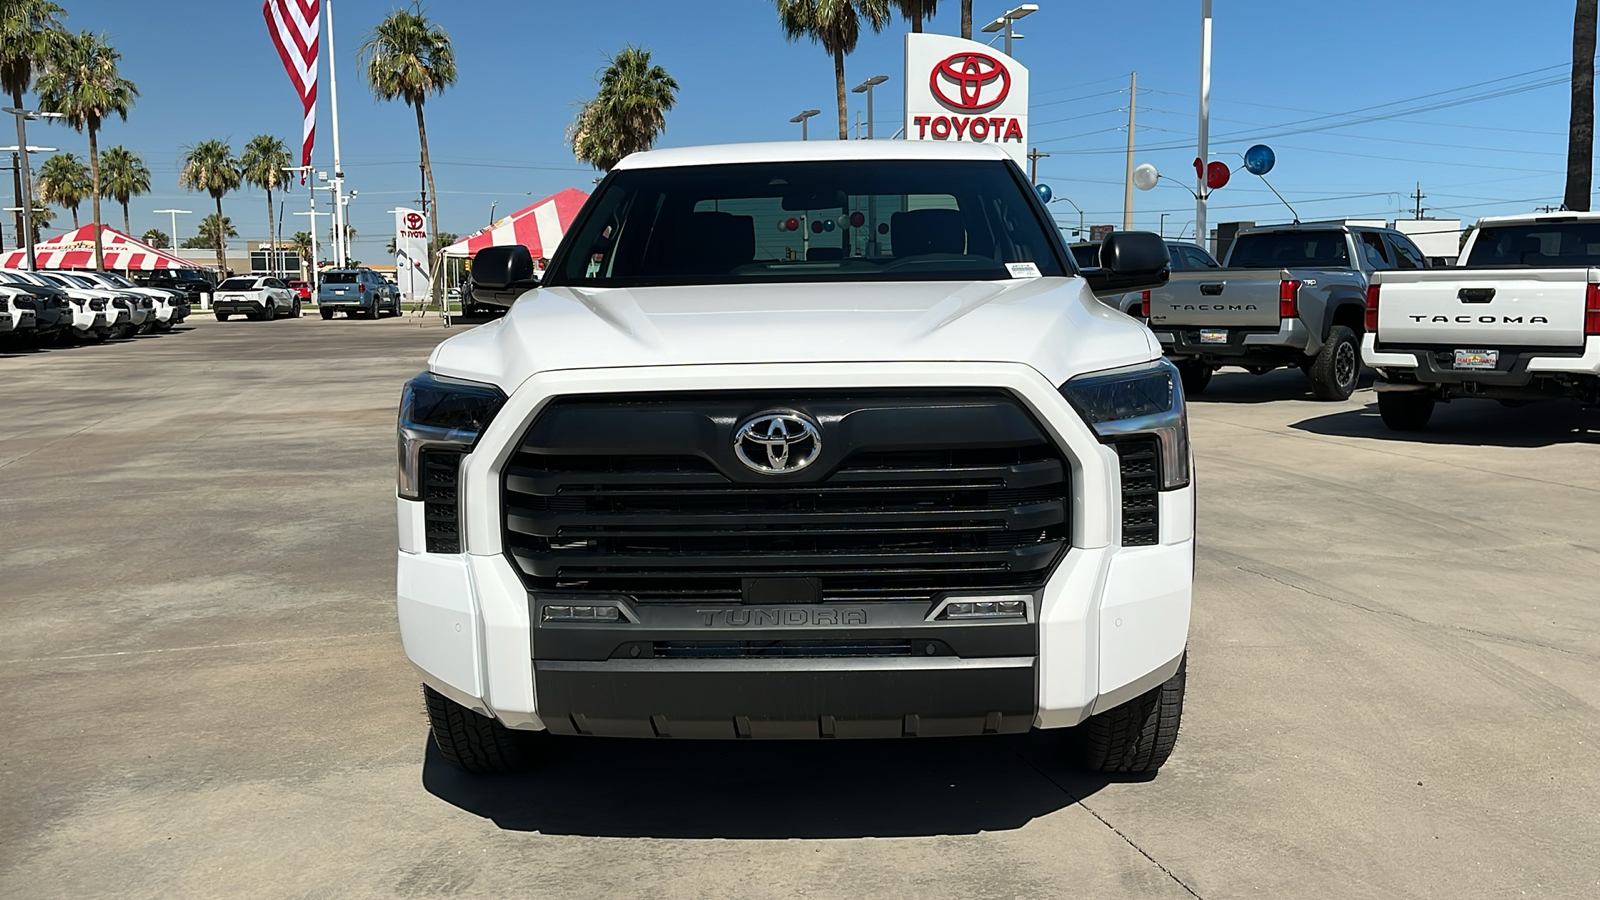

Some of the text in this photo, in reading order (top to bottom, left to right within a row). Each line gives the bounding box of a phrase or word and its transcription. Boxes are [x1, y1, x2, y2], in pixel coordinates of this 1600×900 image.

[914, 116, 1023, 143] TOYOTA
[1409, 315, 1548, 324] TACOMA
[696, 608, 867, 626] TUNDRA
